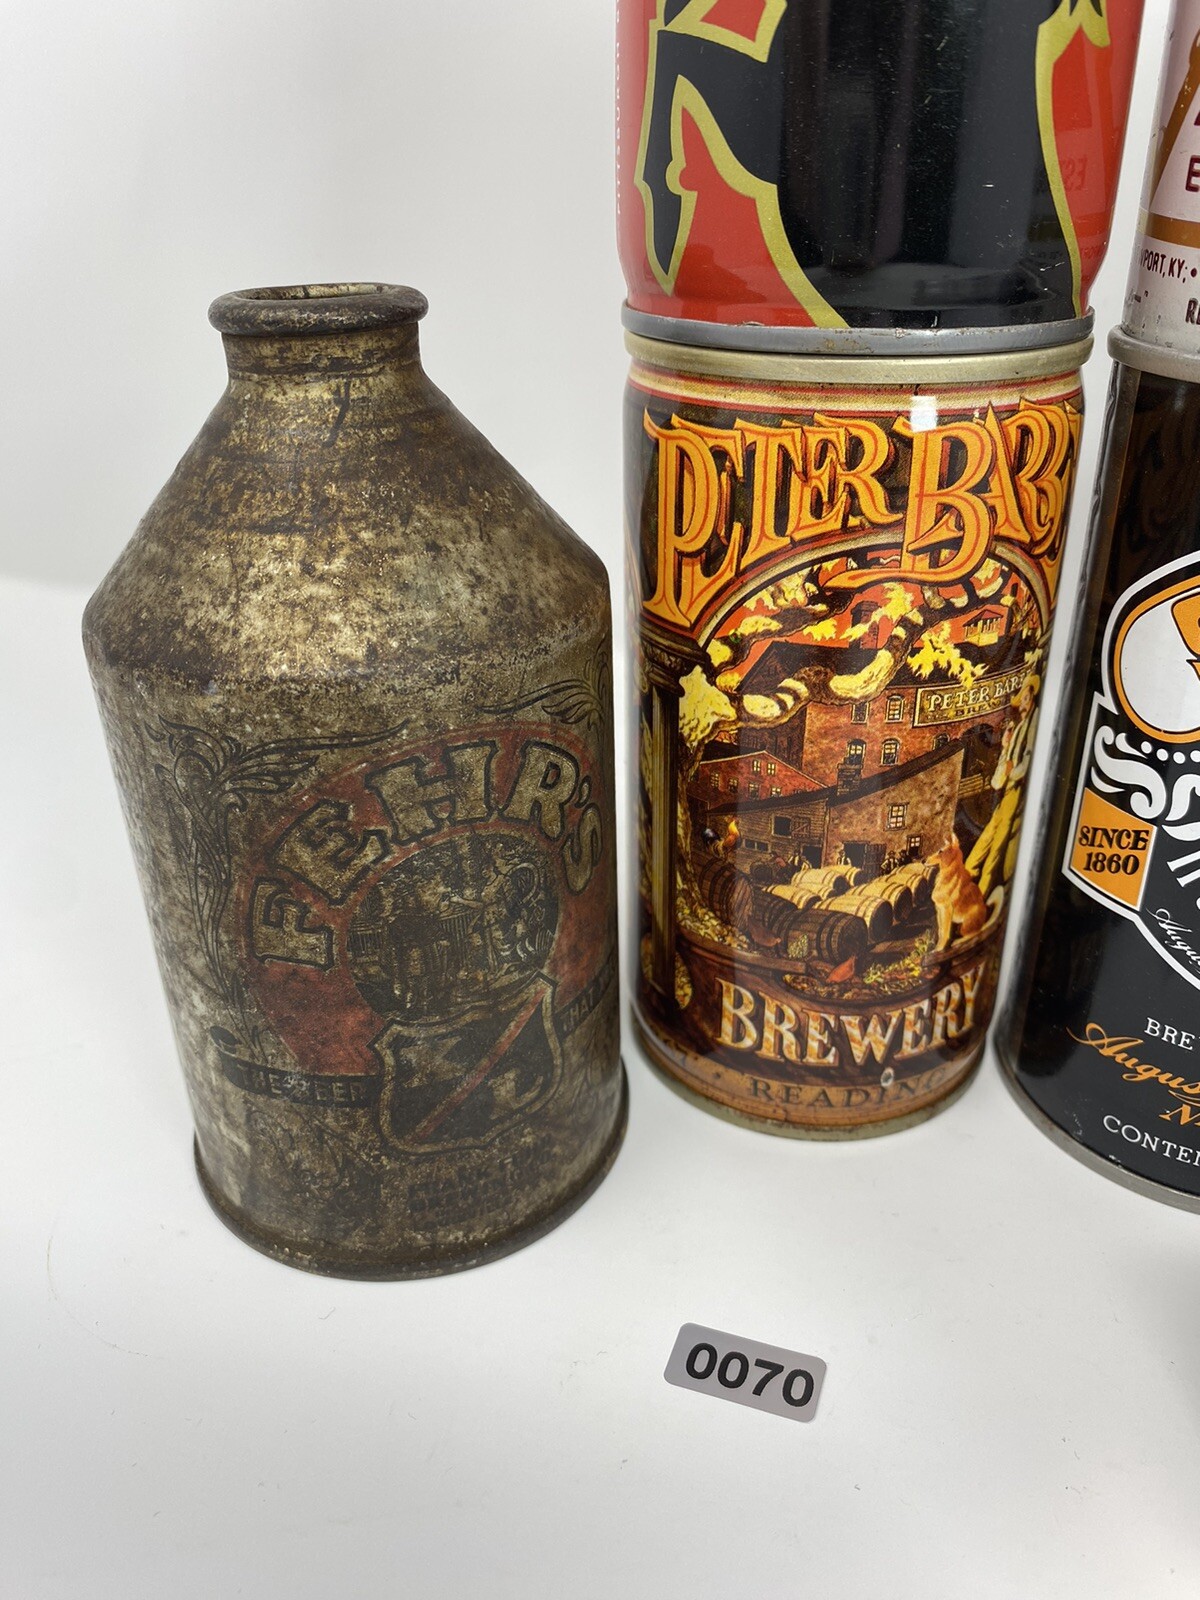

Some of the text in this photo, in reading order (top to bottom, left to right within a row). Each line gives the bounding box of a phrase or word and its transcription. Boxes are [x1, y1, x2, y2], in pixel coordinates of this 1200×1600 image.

[643, 407, 903, 628] PETER
[928, 686, 990, 712] PETER
[1078, 825, 1150, 851] SINCE
[1083, 852, 1141, 876] 1860
[715, 962, 986, 1068] BREWERY
[1143, 1017, 1200, 1051] BRE
[685, 1342, 815, 1408] 0070
